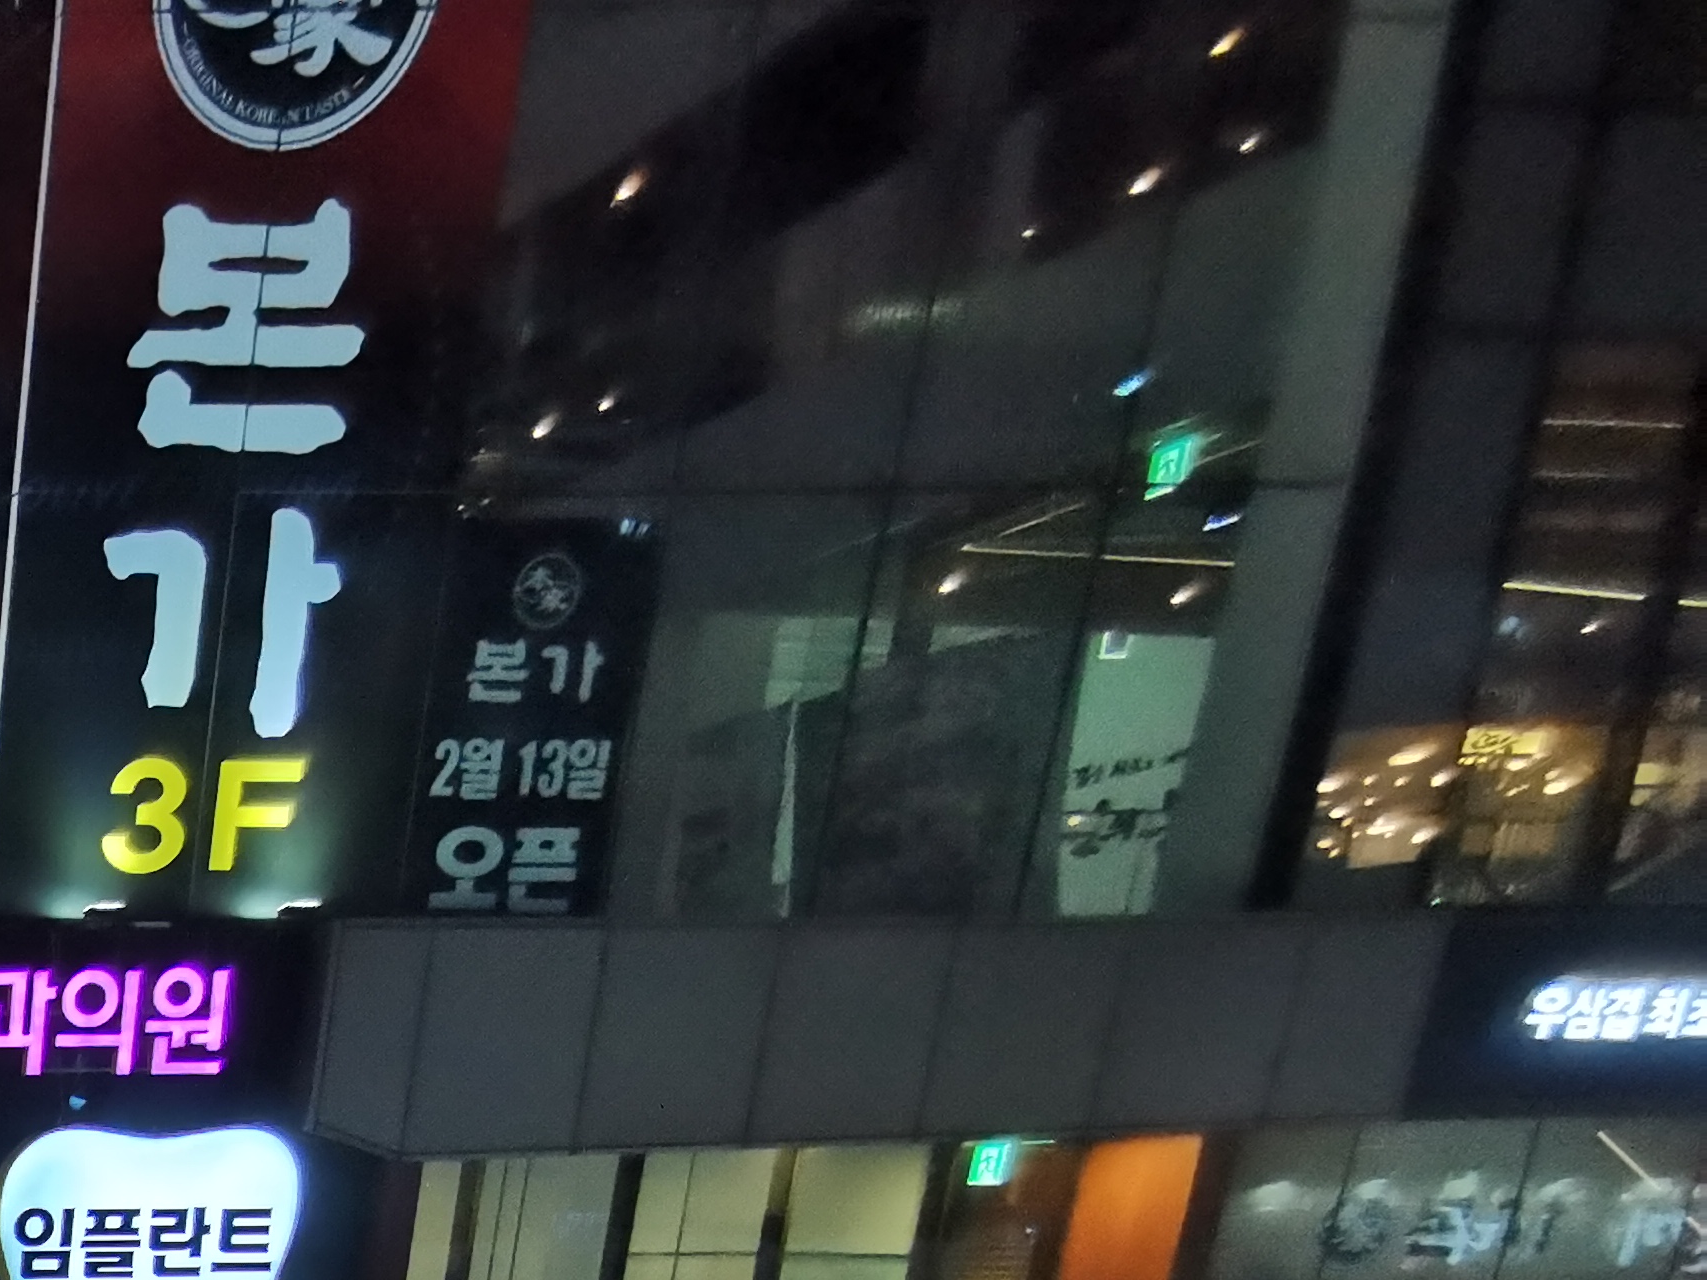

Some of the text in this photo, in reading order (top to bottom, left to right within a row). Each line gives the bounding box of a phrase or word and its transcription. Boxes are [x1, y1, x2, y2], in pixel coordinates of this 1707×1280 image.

[104, 199, 365, 738] 본가
[465, 639, 604, 703] 본가
[432, 738, 609, 798] 2월 13일
[103, 754, 307, 873] 3F
[430, 827, 582, 912] 오픈
[12, 1206, 274, 1280] 임플란트
